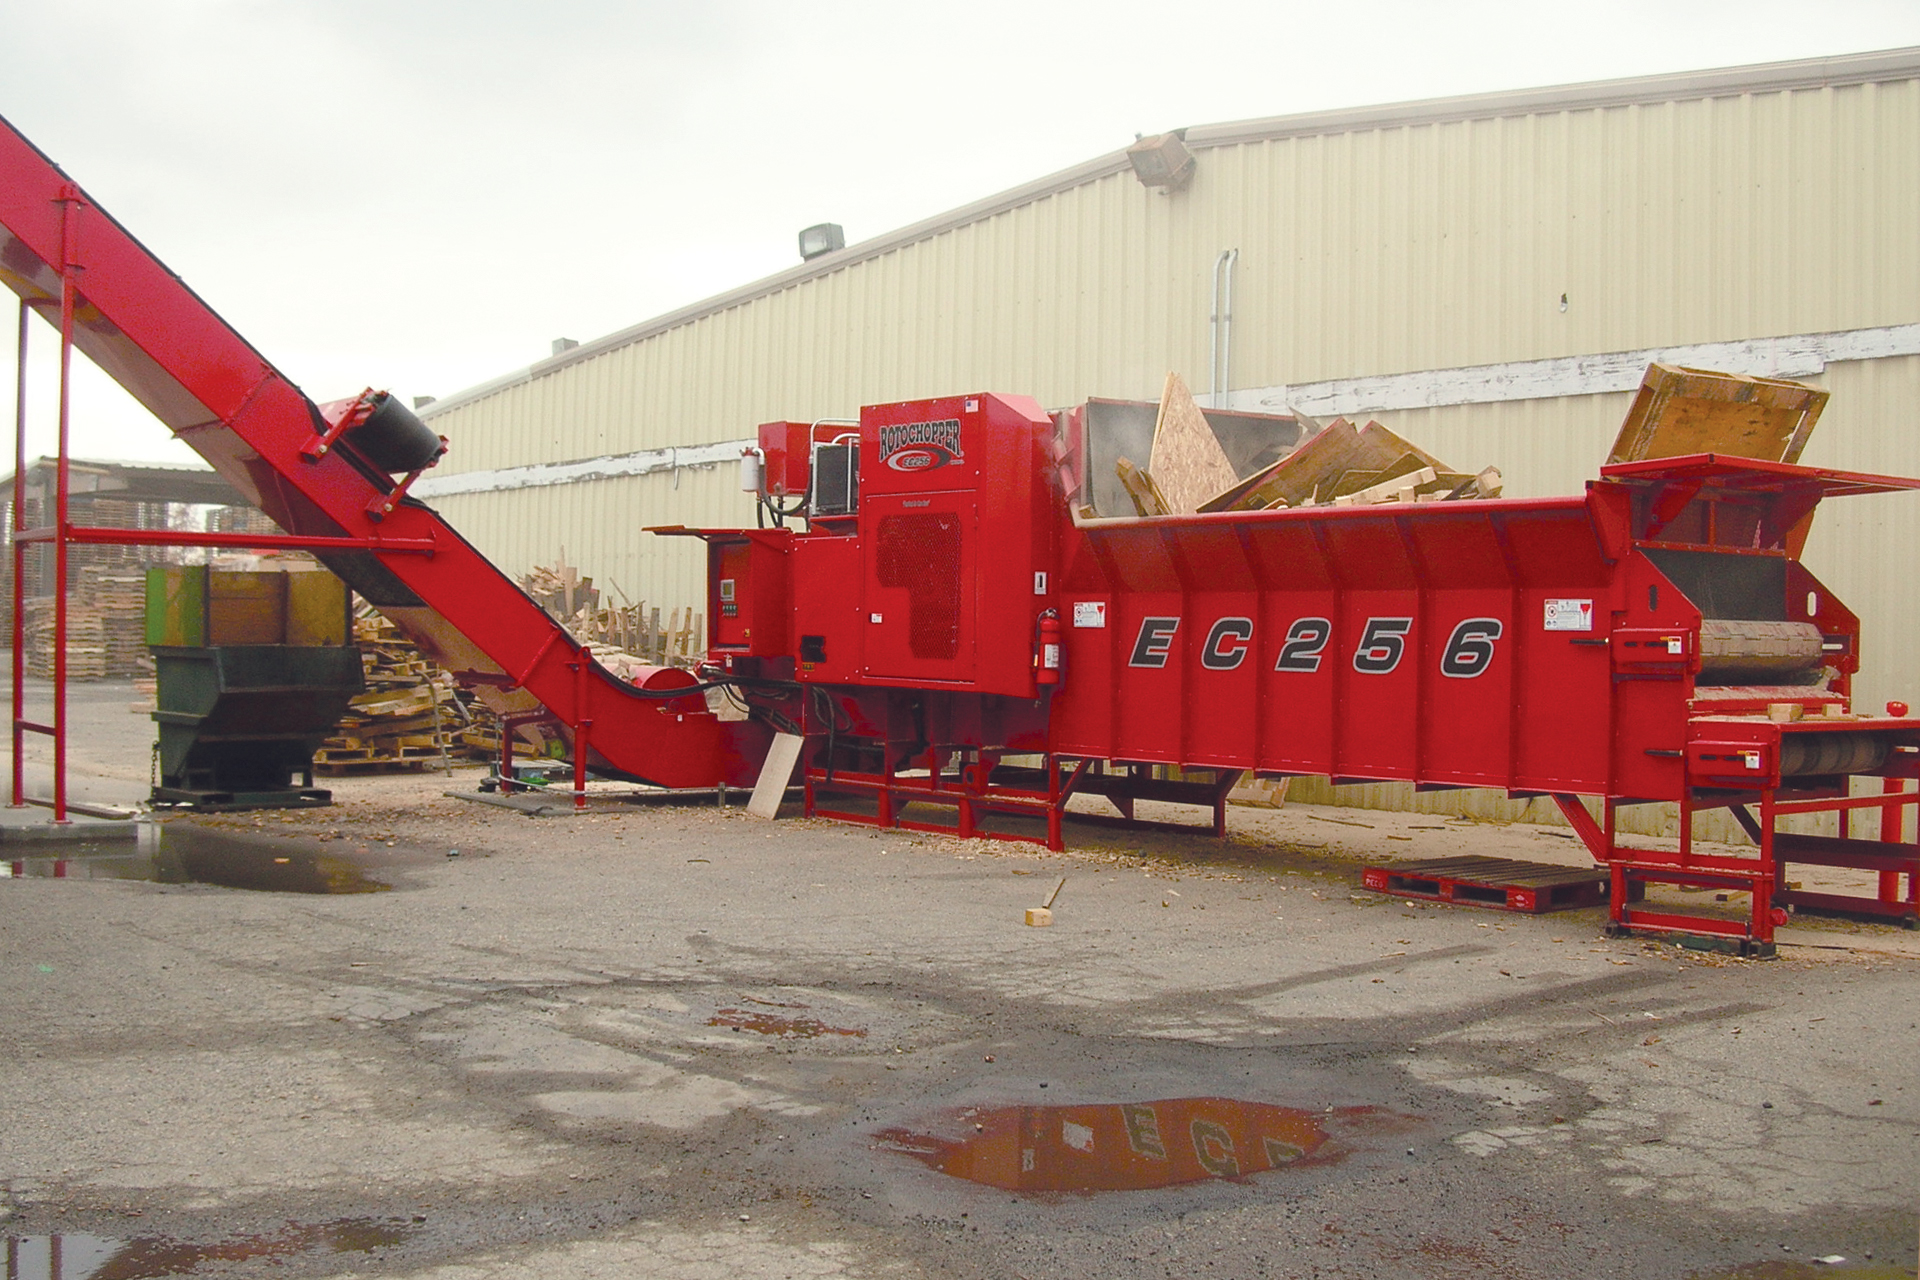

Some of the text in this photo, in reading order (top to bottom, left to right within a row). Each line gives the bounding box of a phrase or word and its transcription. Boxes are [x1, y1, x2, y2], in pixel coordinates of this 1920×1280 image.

[879, 418, 961, 464] ROTOCHOPPER
[902, 456, 931, 468] EC256
[1128, 616, 1503, 678] EC256
